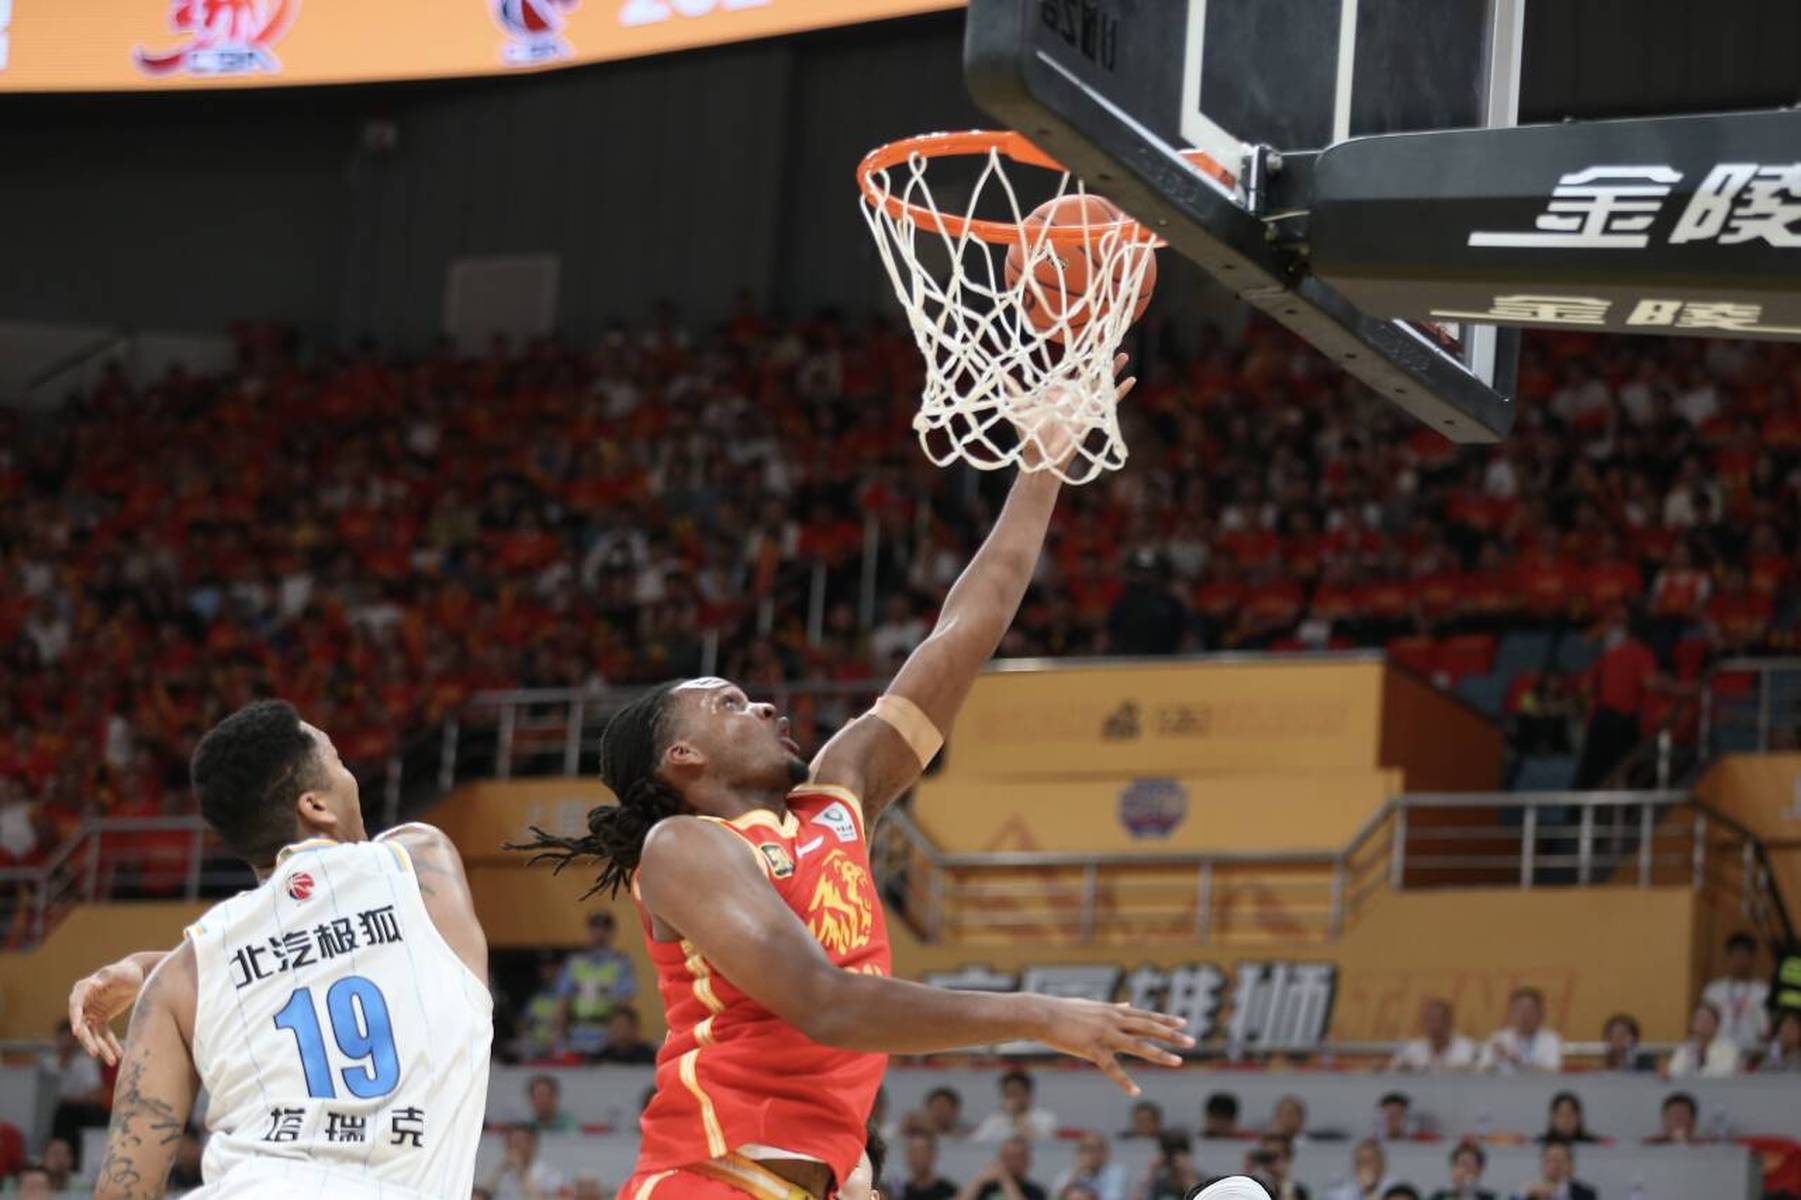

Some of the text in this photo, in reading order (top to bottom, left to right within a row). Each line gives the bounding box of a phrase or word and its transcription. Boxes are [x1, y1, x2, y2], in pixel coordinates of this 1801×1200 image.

[1468, 163, 1801, 247] 金陵
[231, 905, 402, 989] 北汽极狐
[273, 976, 400, 1099] 19
[264, 1106, 426, 1147] 塔瑞克
